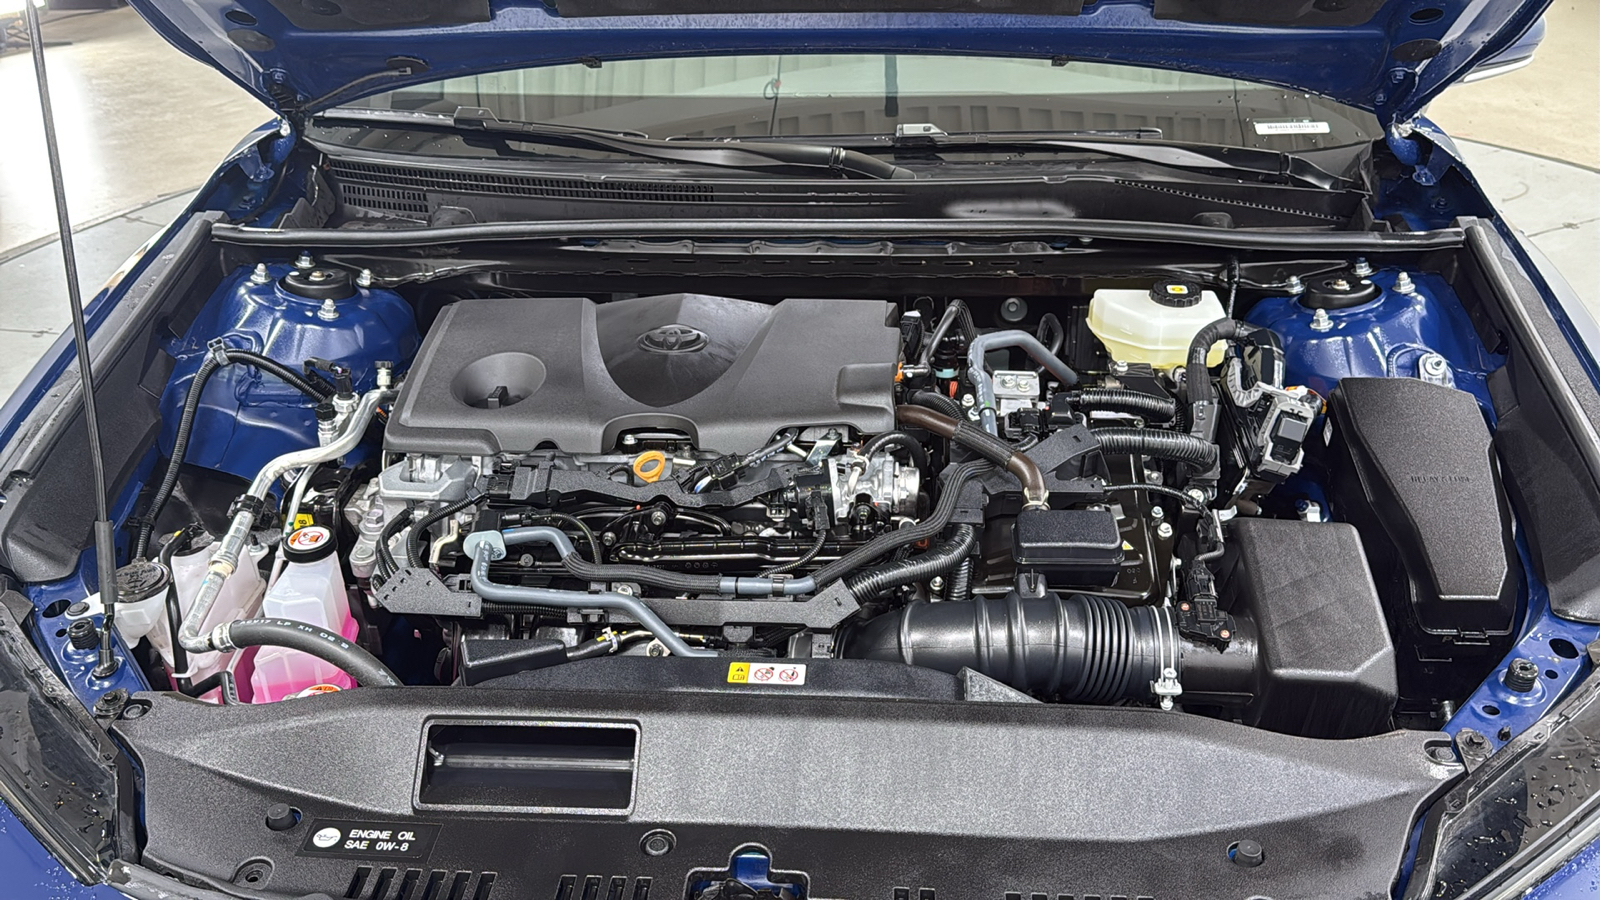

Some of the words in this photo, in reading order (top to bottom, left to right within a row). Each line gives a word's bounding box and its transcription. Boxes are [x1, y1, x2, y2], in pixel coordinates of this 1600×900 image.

[349, 829, 392, 840] ENGINE
[397, 831, 416, 841] OIL
[344, 840, 370, 850] SAE
[375, 842, 409, 852] 0W-8
